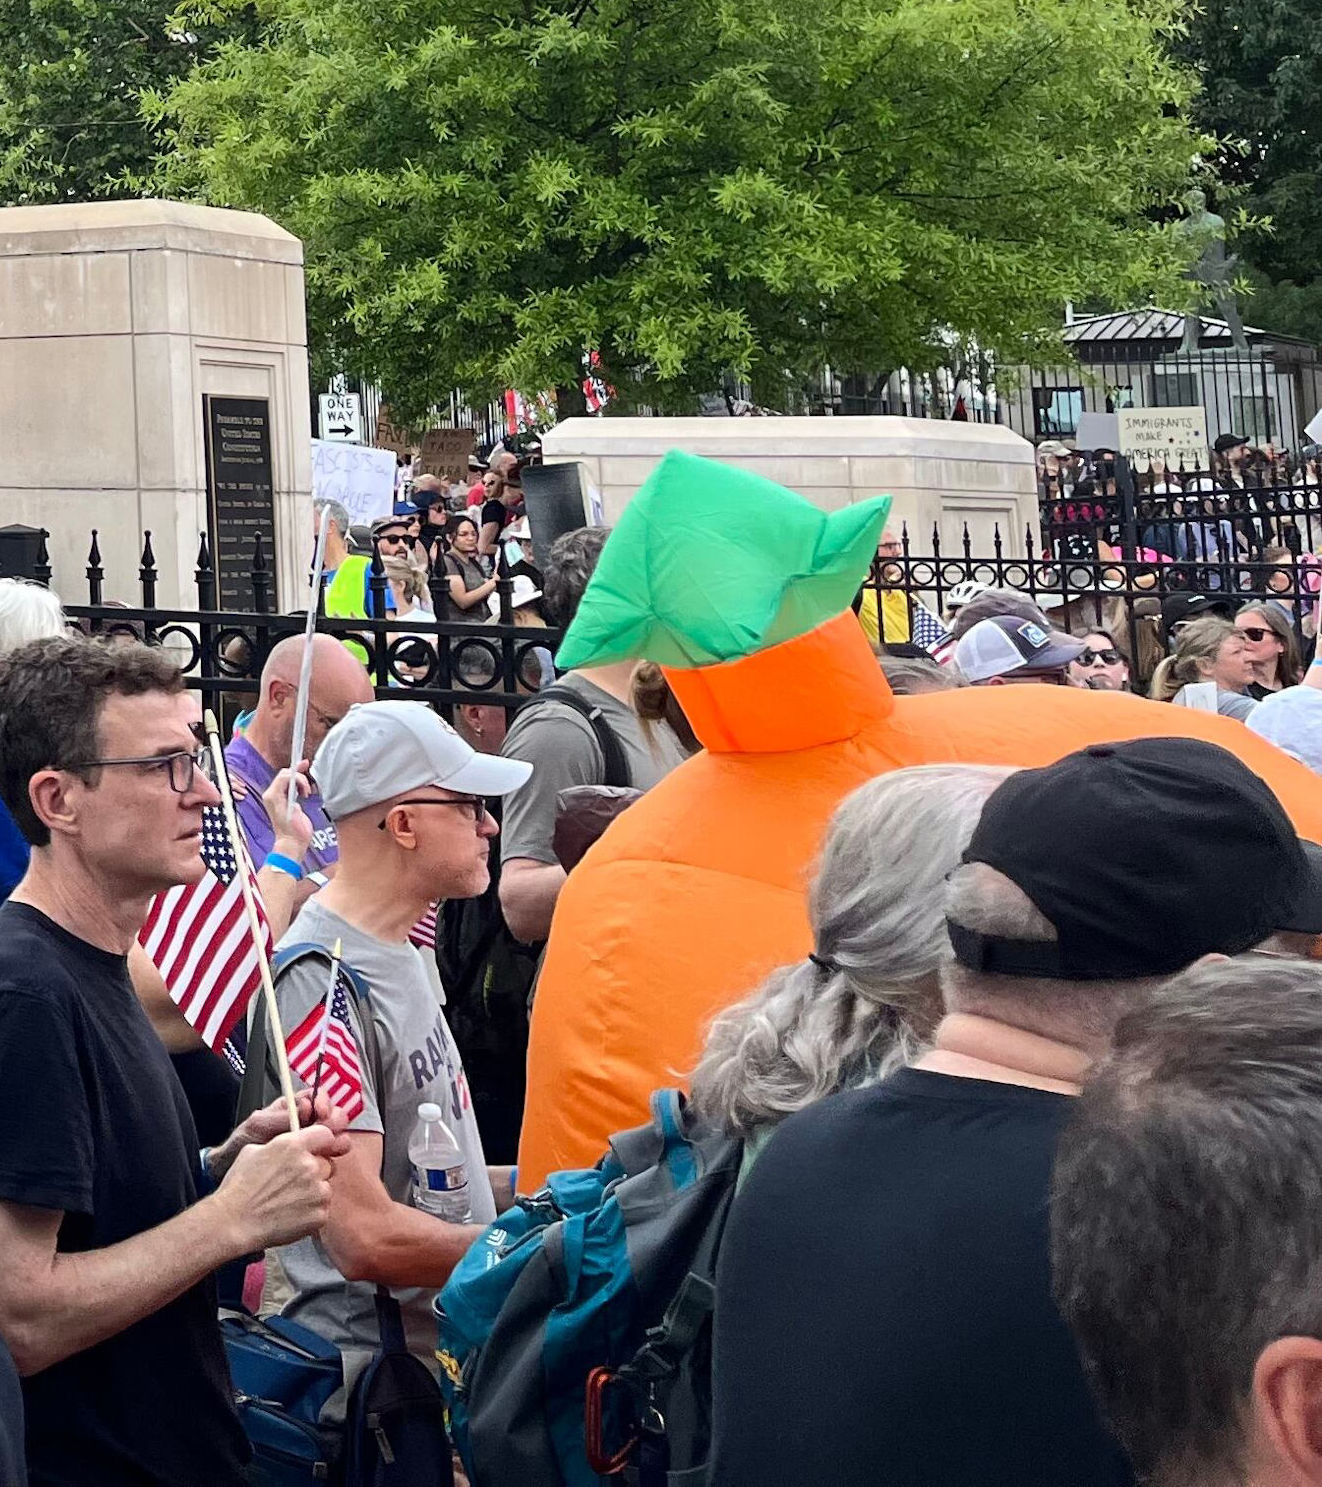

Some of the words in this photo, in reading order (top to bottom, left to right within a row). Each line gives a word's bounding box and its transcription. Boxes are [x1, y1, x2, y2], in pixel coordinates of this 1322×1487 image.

[327, 398, 353, 409] ONE
[327, 411, 354, 422] WAY
[1125, 417, 1193, 430] IMMIGRANTS
[1135, 431, 1163, 442] MAKE
[1124, 447, 1171, 460] AMERICA
